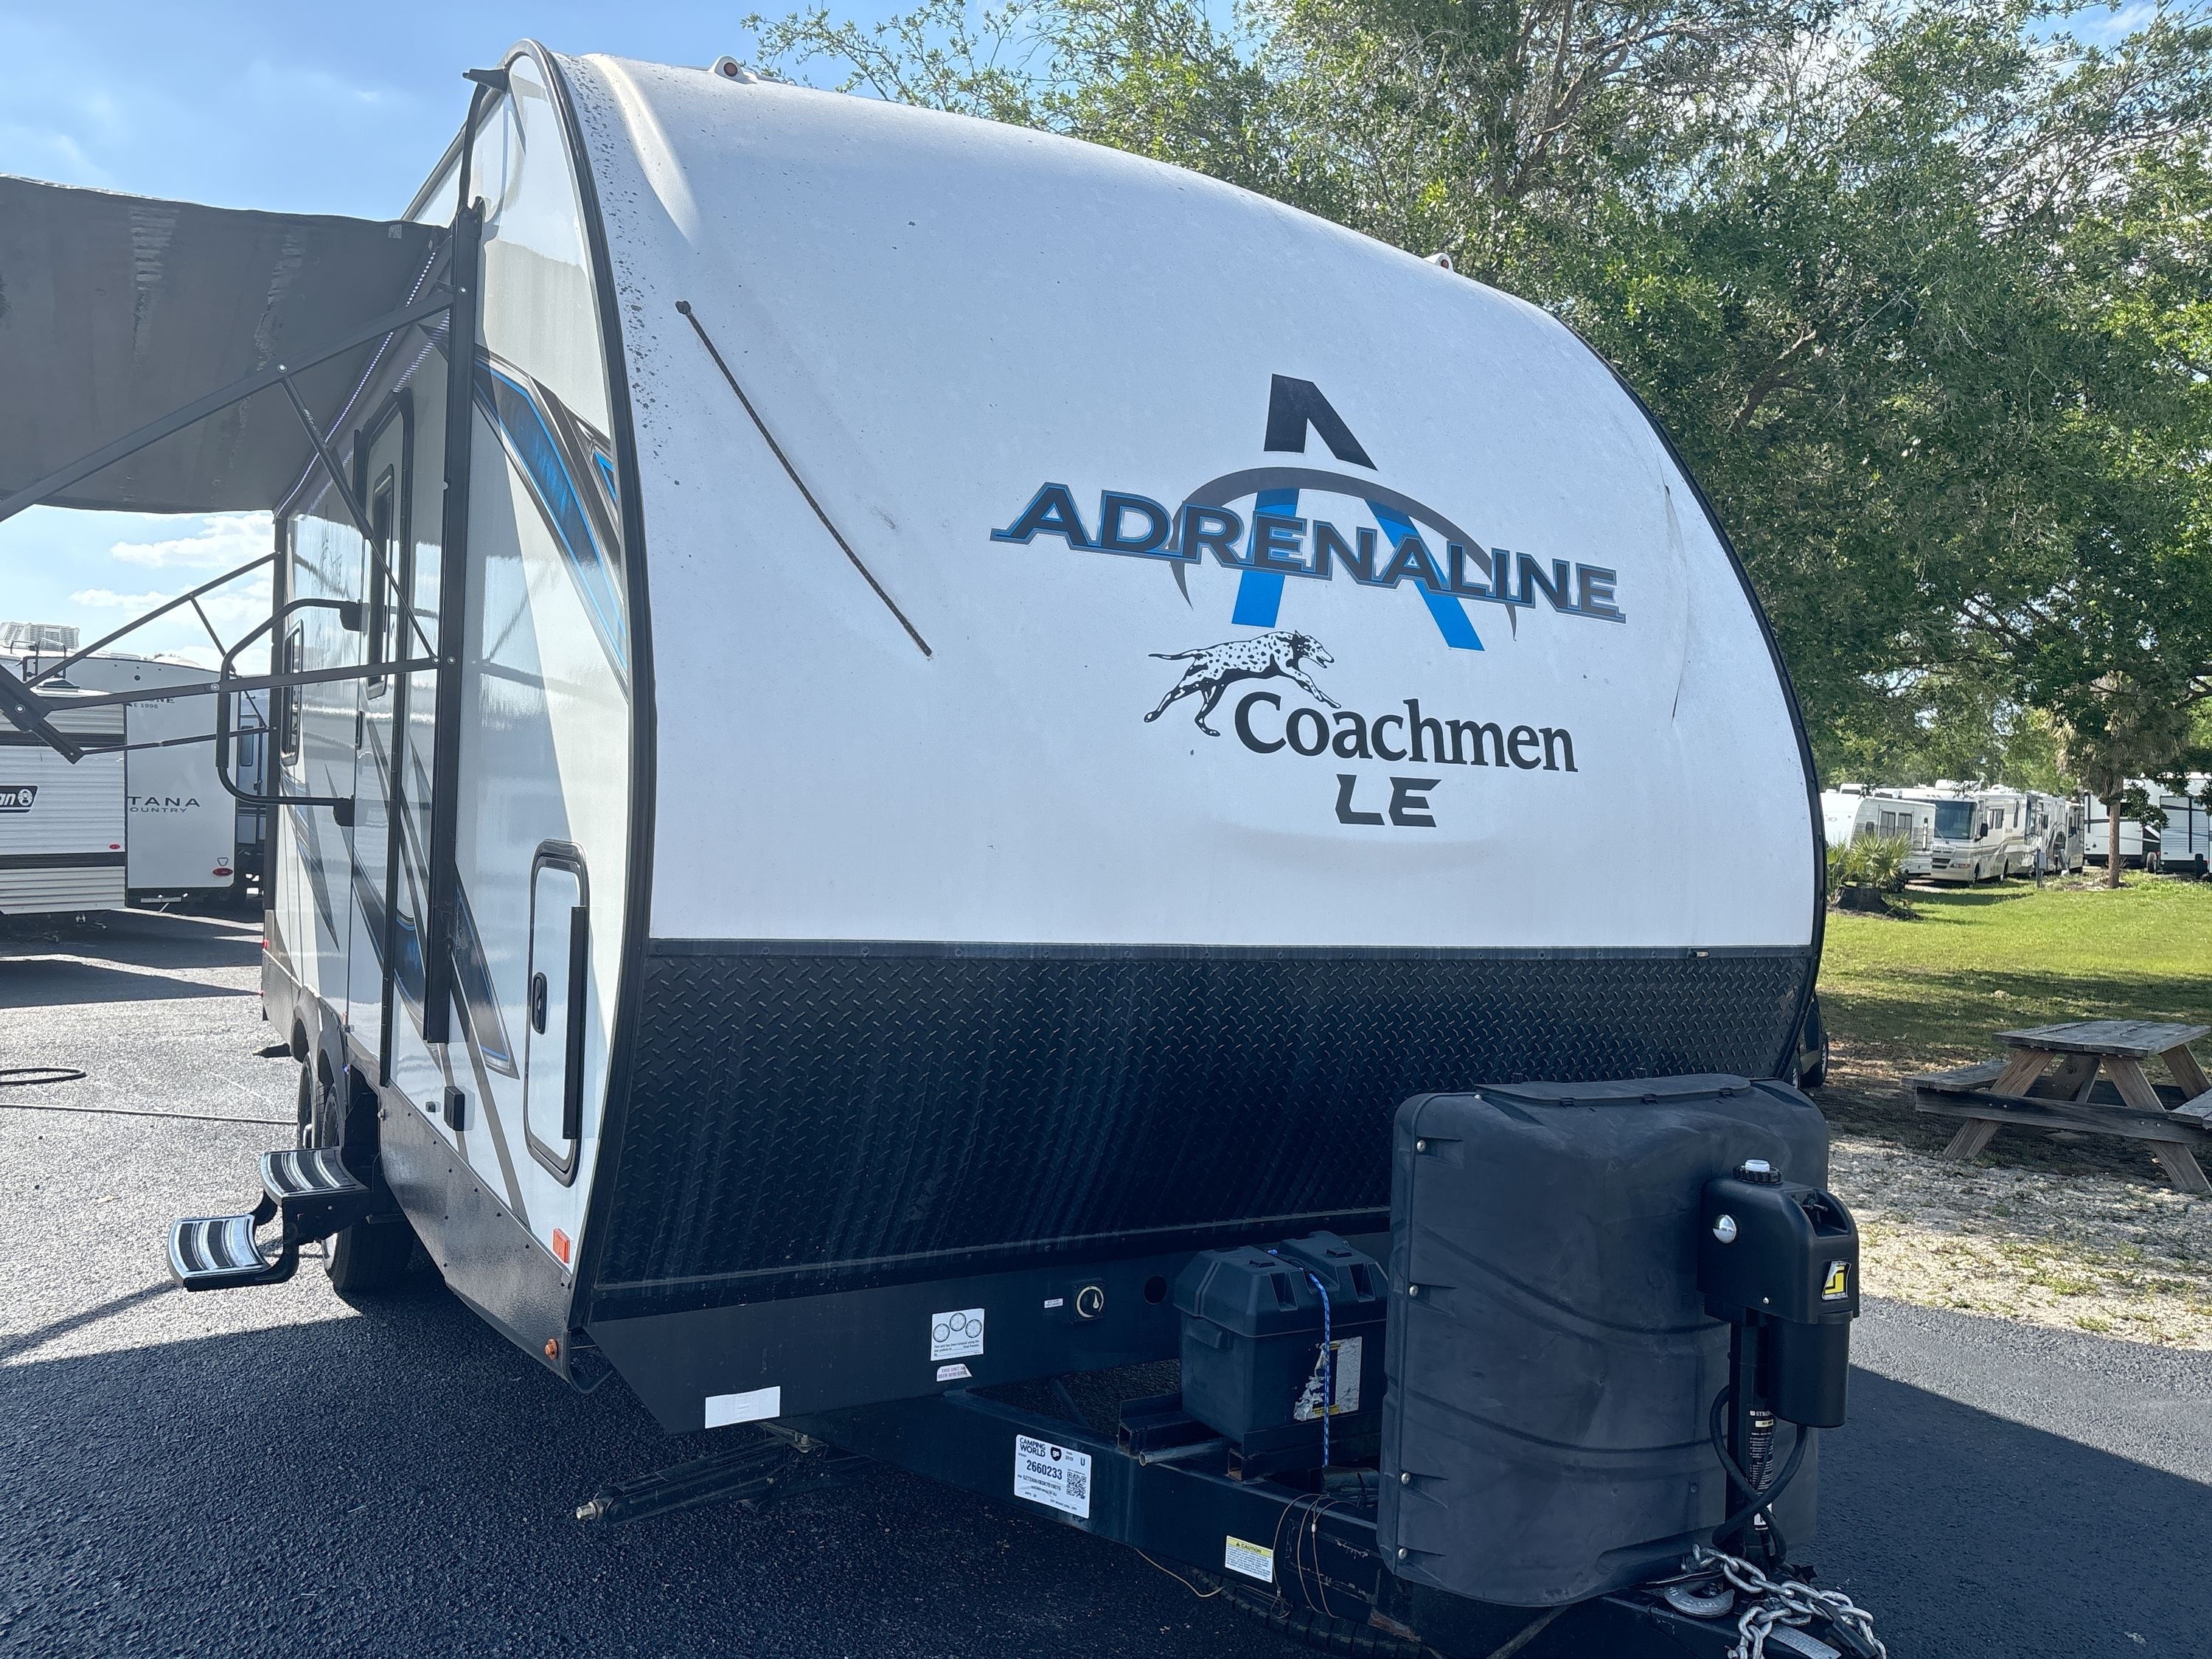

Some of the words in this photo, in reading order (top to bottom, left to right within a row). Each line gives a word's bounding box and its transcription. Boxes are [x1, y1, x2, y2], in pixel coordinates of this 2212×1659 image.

[990, 482, 1626, 624] ADRENALINE
[1234, 691, 1578, 773] Coachmen
[1335, 774, 1442, 827] LE
[1020, 1437, 1046, 1450] CAMPING
[1020, 1443, 1046, 1457] WORLD
[1026, 1460, 1062, 1481] 2660233
[1080, 1457, 1085, 1467] U
[1241, 1543, 1262, 1554] CAUTION
